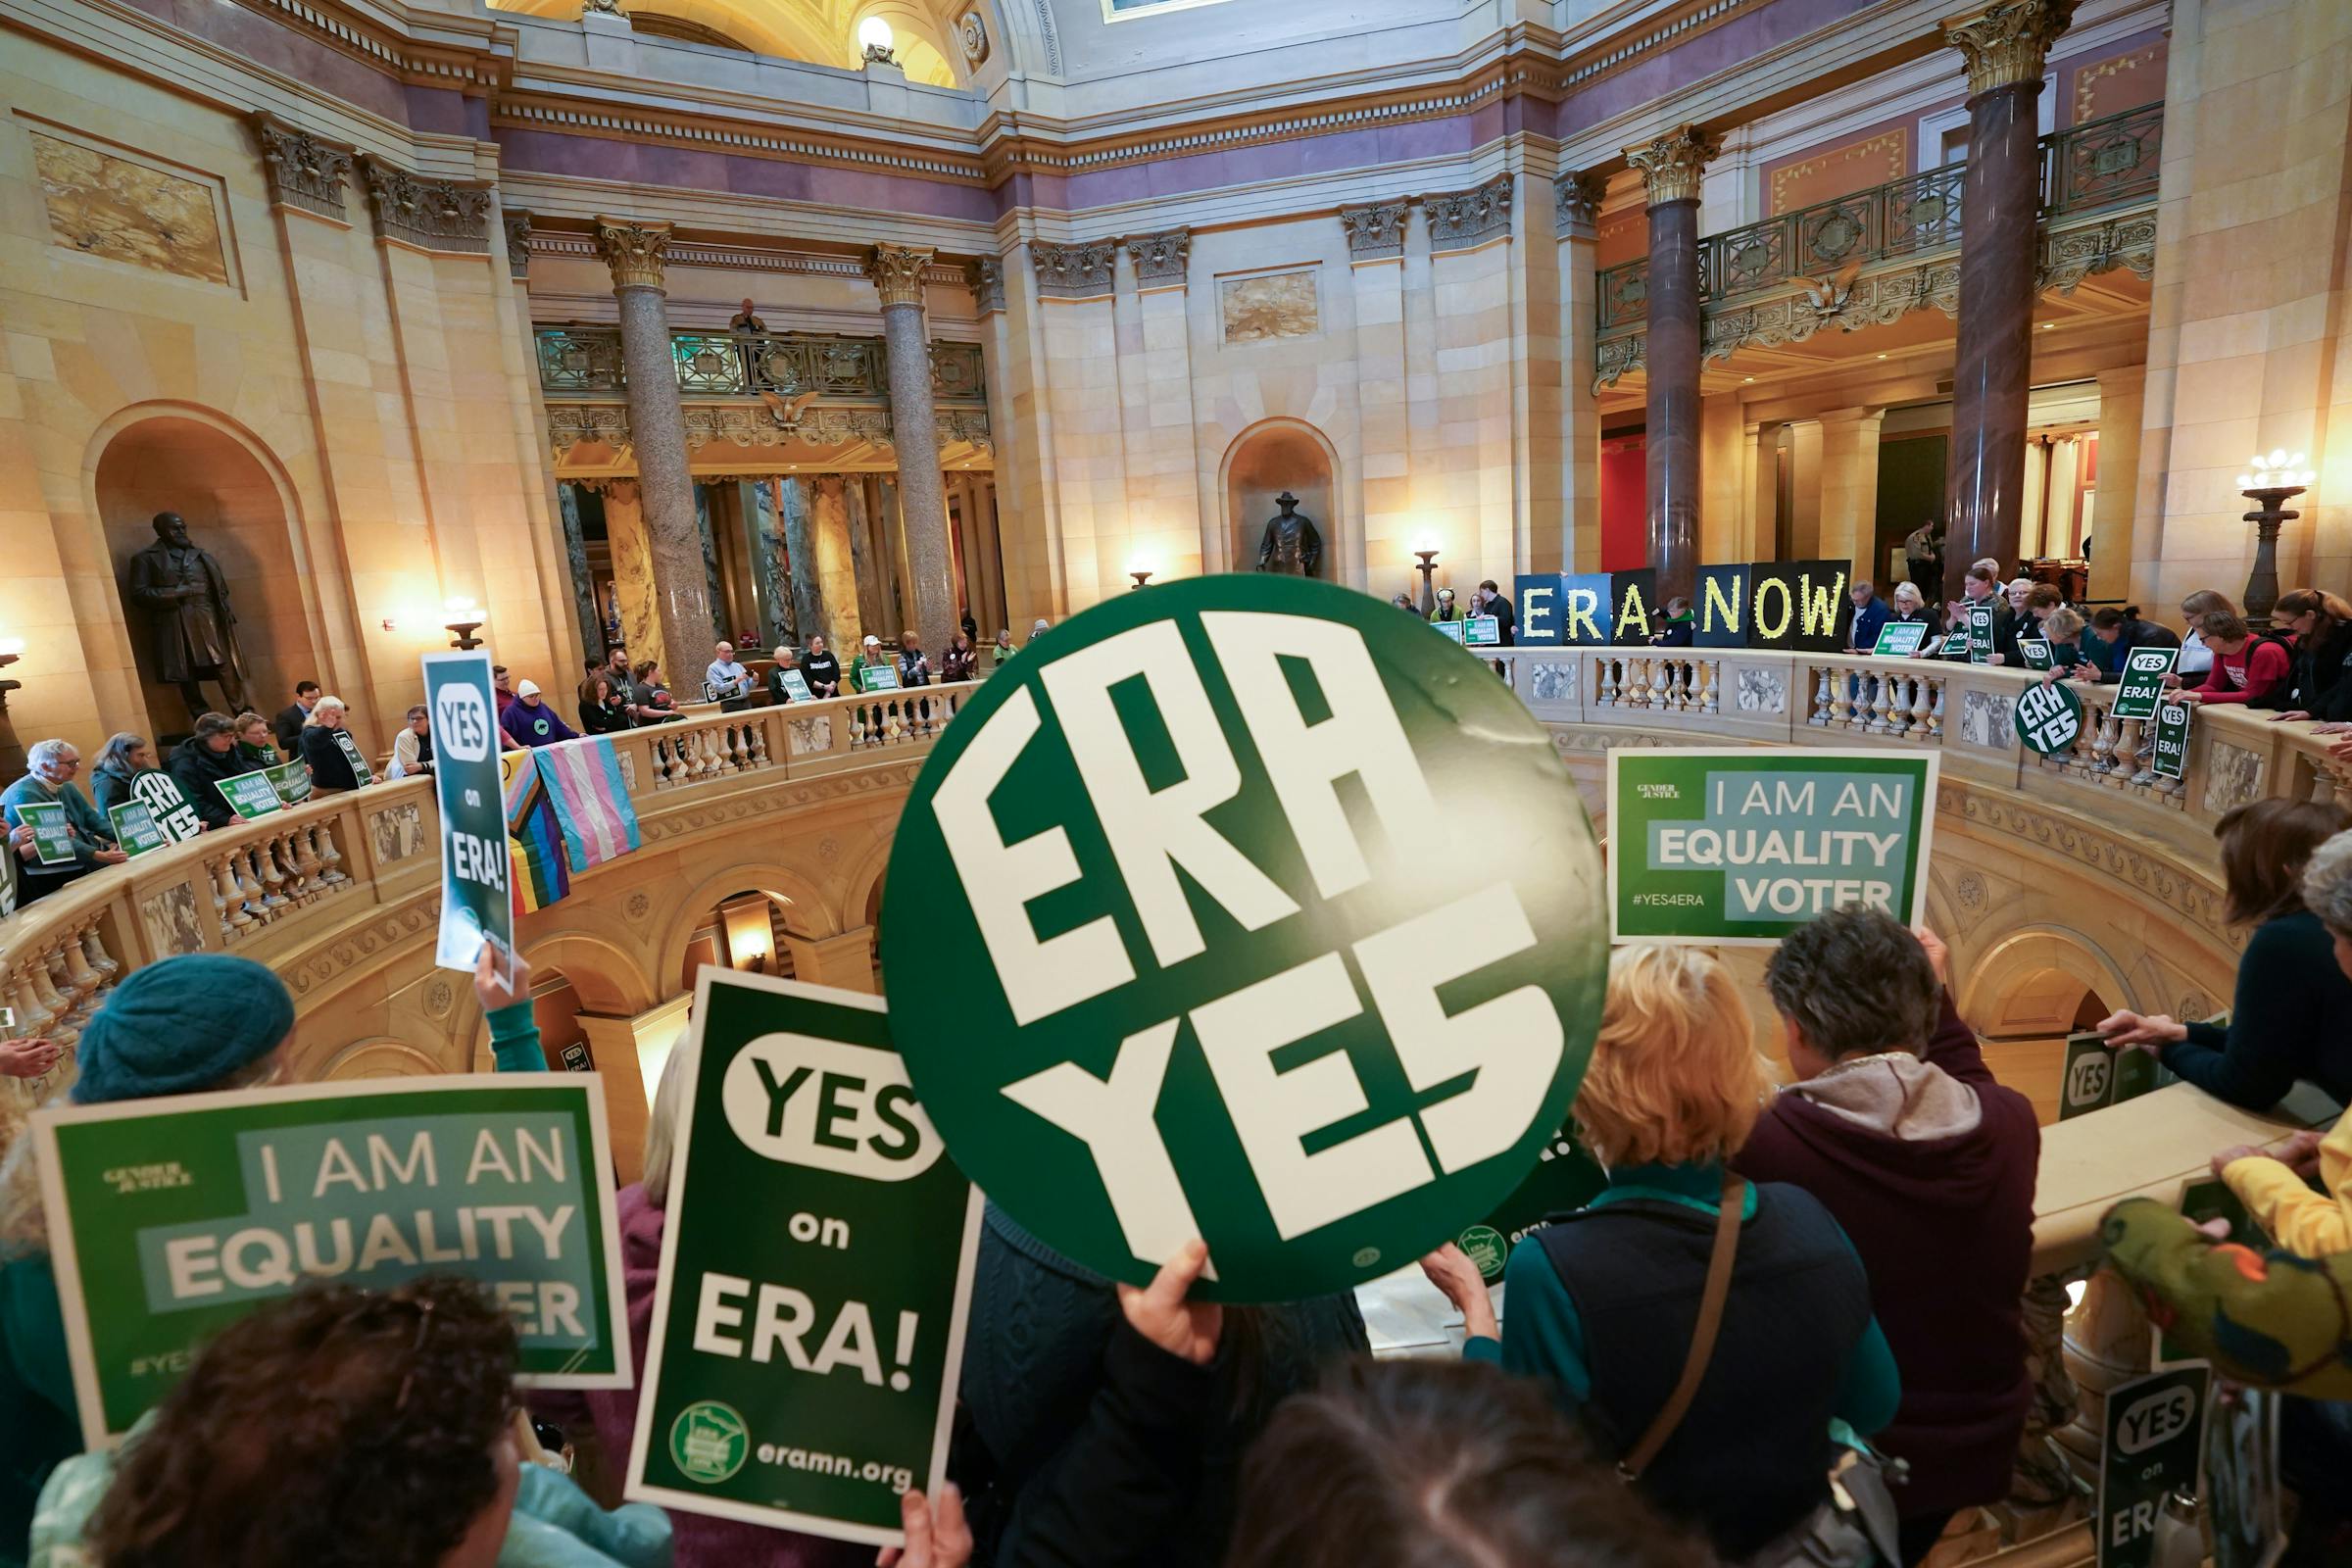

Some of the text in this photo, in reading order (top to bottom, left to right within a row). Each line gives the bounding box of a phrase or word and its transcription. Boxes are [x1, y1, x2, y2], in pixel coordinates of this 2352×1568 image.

[1523, 571, 1844, 640] ERA NOW
[1974, 615, 1987, 624] YES
[1949, 632, 1968, 641] ERA
[1972, 639, 1990, 649] ERA!
[2026, 647, 2045, 657] YES
[2136, 658, 2163, 668] YES
[2018, 684, 2066, 730] ERA
[2123, 686, 2157, 699] ERA!
[441, 702, 483, 749] YES
[2027, 709, 2078, 753] YES
[2165, 709, 2182, 722] YES
[2158, 740, 2181, 756] ERA!
[133, 772, 184, 819] ERA
[234, 786, 271, 804] EQUALITY
[465, 788, 481, 808] on
[1716, 780, 1903, 818] I AM AN
[121, 818, 153, 837] EQUALITY
[157, 804, 201, 846] YES
[931, 611, 1457, 1027] ERA
[453, 831, 505, 893] ERA!
[1659, 829, 1901, 866] EQUALITY
[1632, 894, 1705, 906] #YES4ERA
[1735, 878, 1893, 914] VOTER
[1000, 881, 1565, 1282] YES
[2074, 1062, 2105, 1099] YES
[751, 1057, 921, 1161] YES
[260, 1127, 566, 1203] I AM AN
[788, 1211, 851, 1250] on
[165, 1205, 576, 1299] EQUALITY
[693, 1272, 919, 1393] ERA!
[2126, 1396, 2186, 1446] YES
[757, 1443, 912, 1495] eramn.org
[2141, 1461, 2164, 1481] on
[2112, 1494, 2164, 1547] ER
